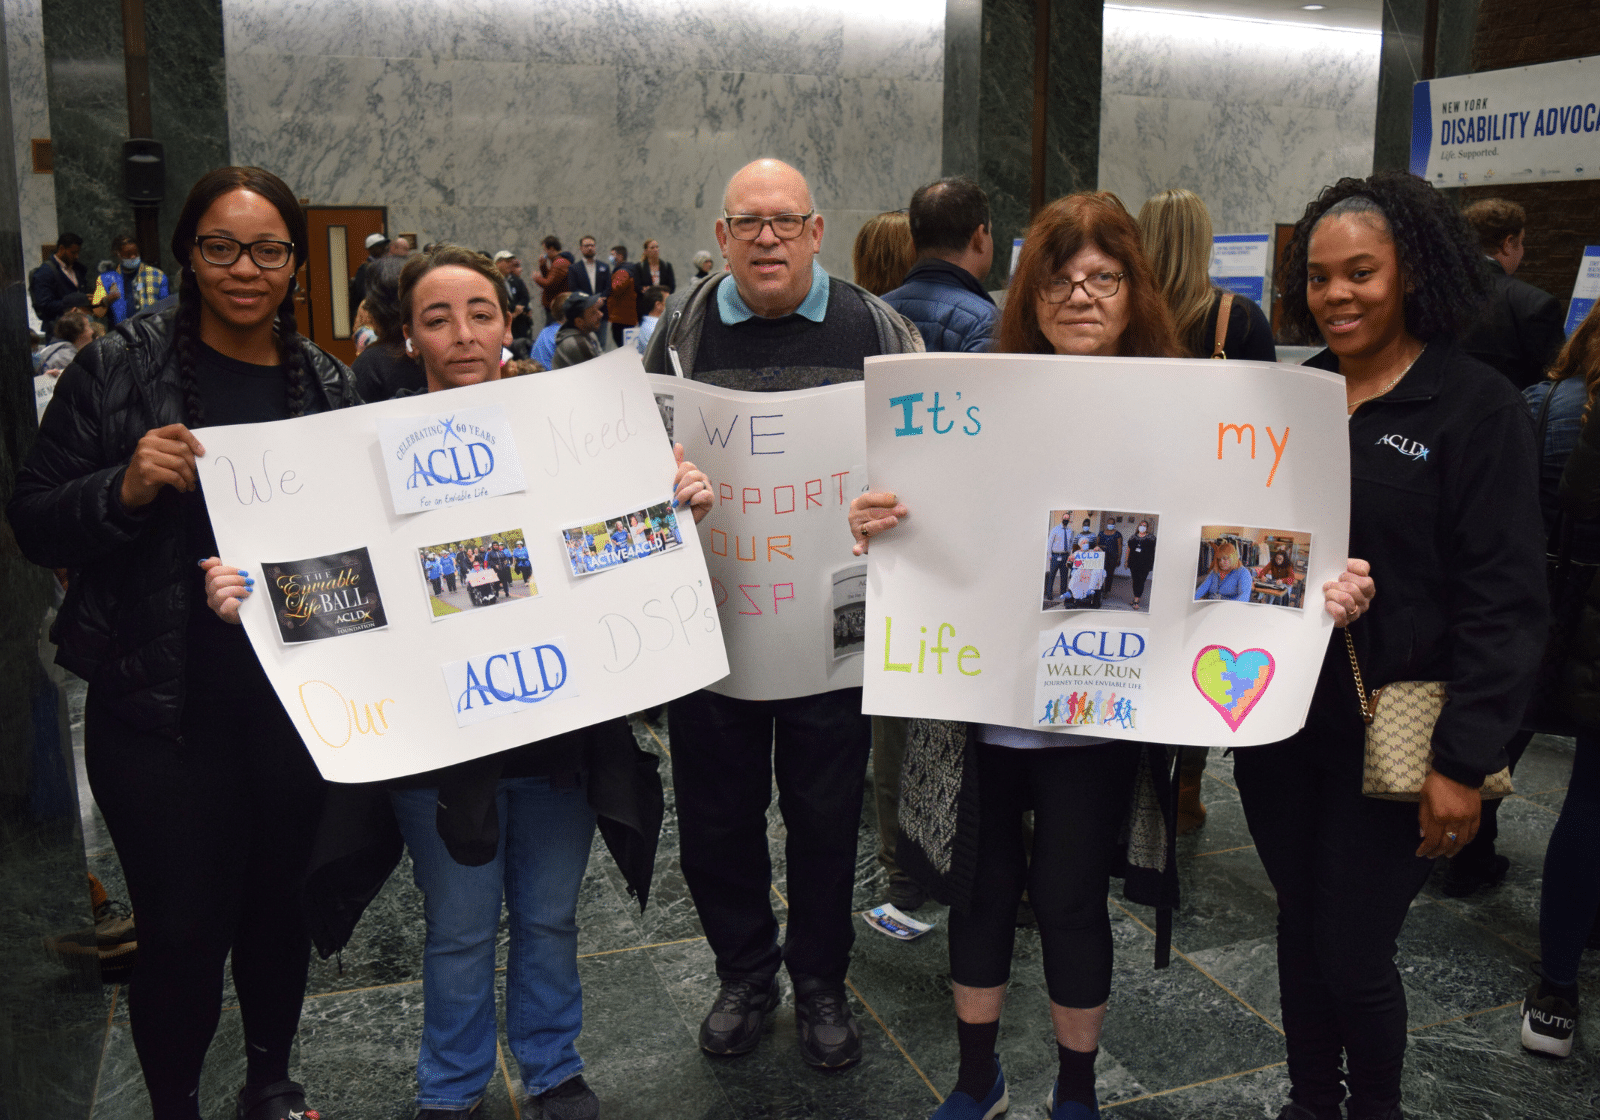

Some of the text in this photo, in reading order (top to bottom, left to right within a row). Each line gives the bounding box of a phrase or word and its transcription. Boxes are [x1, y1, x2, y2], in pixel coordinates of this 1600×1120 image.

[1442, 98, 1488, 114] NEW YORK
[1441, 110, 1530, 146] DISABILITY
[1458, 147, 1499, 160] Supported.
[215, 389, 637, 505] We Need
[396, 423, 496, 460] CELEBRATING 60 YEARS
[699, 407, 785, 455] WE
[889, 391, 1290, 488] It's my
[1375, 433, 1430, 461] ACLD
[406, 442, 495, 490] ACLD
[474, 486, 489, 498] Life
[710, 471, 850, 515] PPORT
[590, 537, 663, 569] ACTIVE4ACLD
[710, 528, 795, 563] OUR
[276, 568, 359, 597] Enviable
[305, 571, 331, 582] THE
[284, 586, 369, 627] Life BALL
[334, 610, 374, 625] ACLD
[337, 622, 376, 635] FOUNDATION
[883, 616, 982, 677] Life
[1042, 630, 1146, 663] ACLD
[298, 580, 716, 749] Our DSP's
[457, 644, 567, 714] ACLD
[1043, 680, 1072, 688] JOURNEY
[1095, 680, 1127, 689] ENVIABLE
[1128, 682, 1142, 690] LIFE
[1530, 1007, 1575, 1030] NAUTIC
